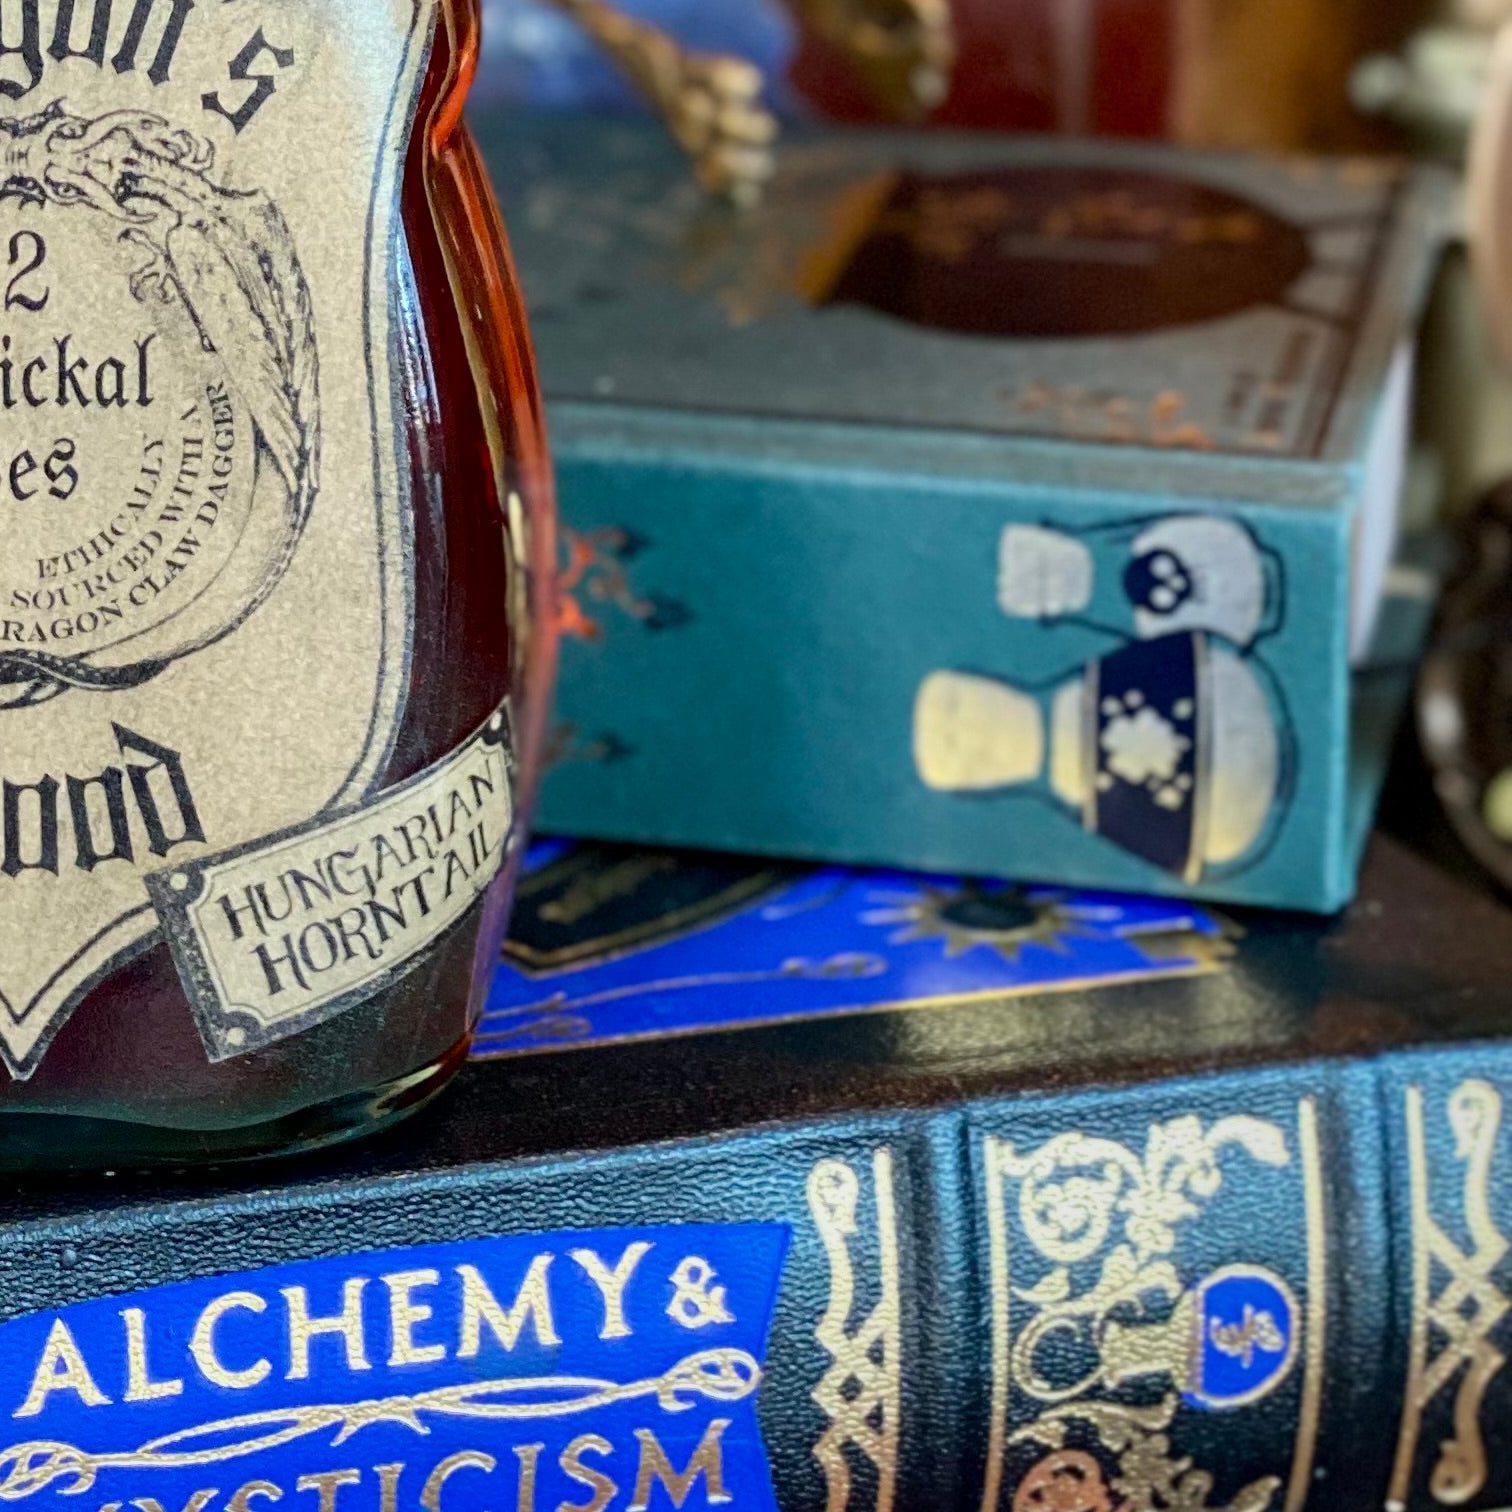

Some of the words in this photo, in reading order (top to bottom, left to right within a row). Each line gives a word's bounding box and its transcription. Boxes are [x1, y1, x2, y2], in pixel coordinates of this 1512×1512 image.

[10, 529, 164, 610] SOURCED
[158, 436, 203, 522] WITH
[37, 431, 164, 579] ETHICALLY
[128, 526, 202, 607] CLAW
[195, 380, 235, 529] DAGGER
[215, 758, 495, 943] HUNGARIAN
[248, 820, 501, 997] HORNTAIL
[10, 1240, 657, 1419] ALCHEMY
[665, 1255, 737, 1329] &
[98, 1418, 733, 1512] TICISM
